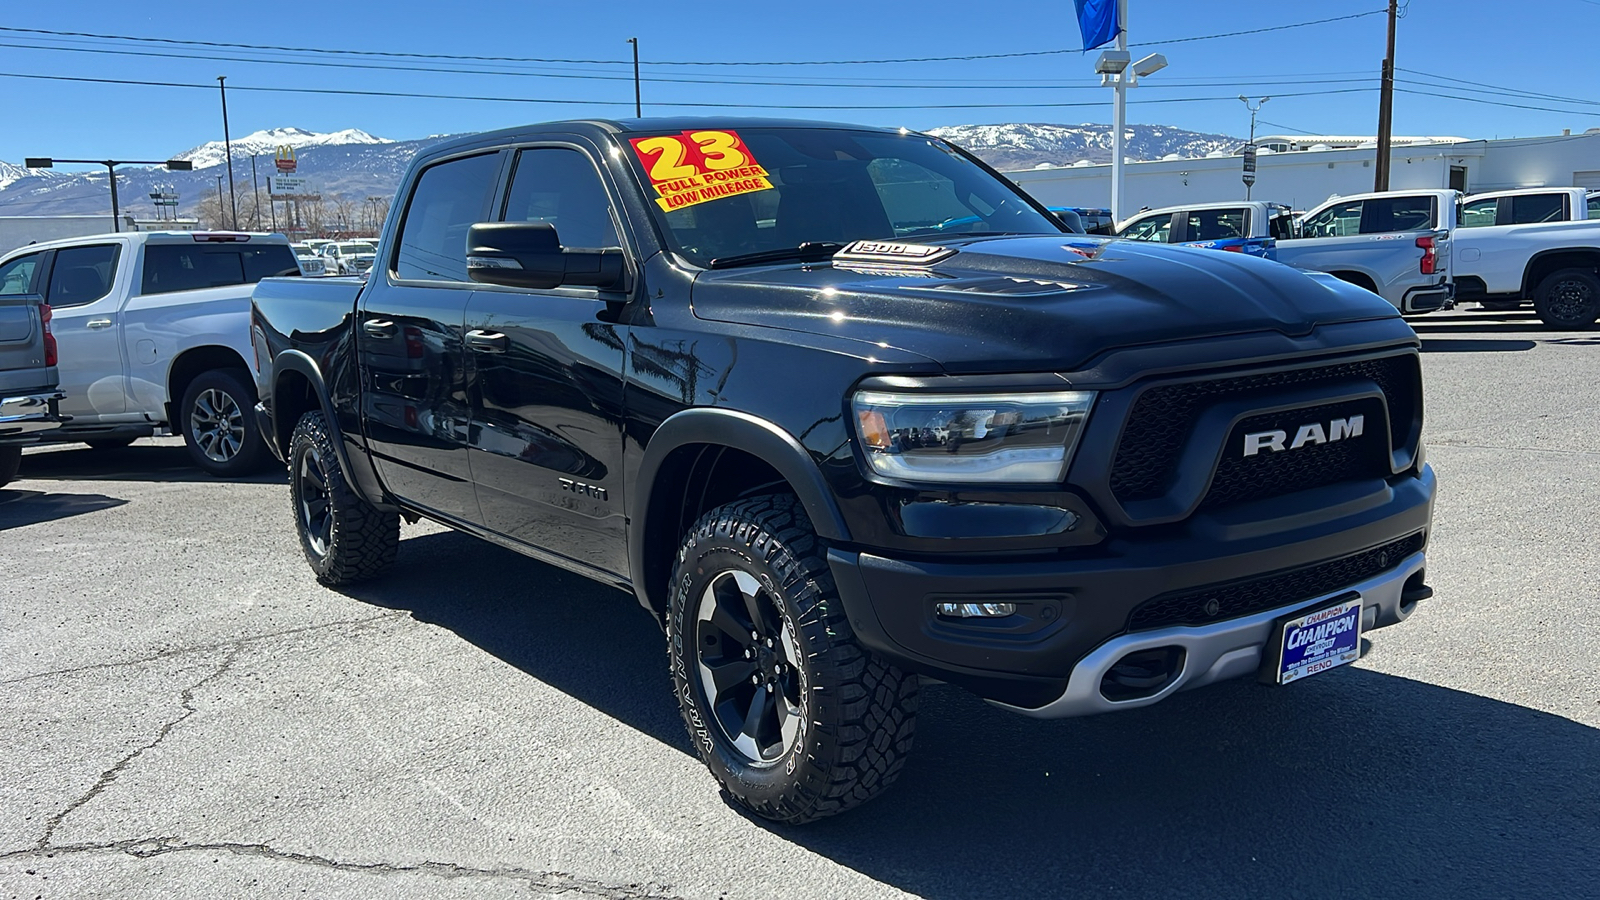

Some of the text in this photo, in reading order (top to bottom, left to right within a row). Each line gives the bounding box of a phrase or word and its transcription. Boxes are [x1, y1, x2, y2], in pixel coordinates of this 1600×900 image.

[636, 131, 749, 181] 23
[657, 166, 763, 195] FULL POWER
[665, 178, 764, 208] LOW MILEAGE
[854, 242, 908, 254] 1500
[1243, 414, 1364, 457] RAM
[1306, 606, 1343, 624] CHAMPION
[1287, 615, 1355, 650] CHAMPION
[1306, 640, 1333, 653] CHEVROLET
[674, 573, 714, 754] WRANGLER
[1306, 660, 1332, 674] RENO
